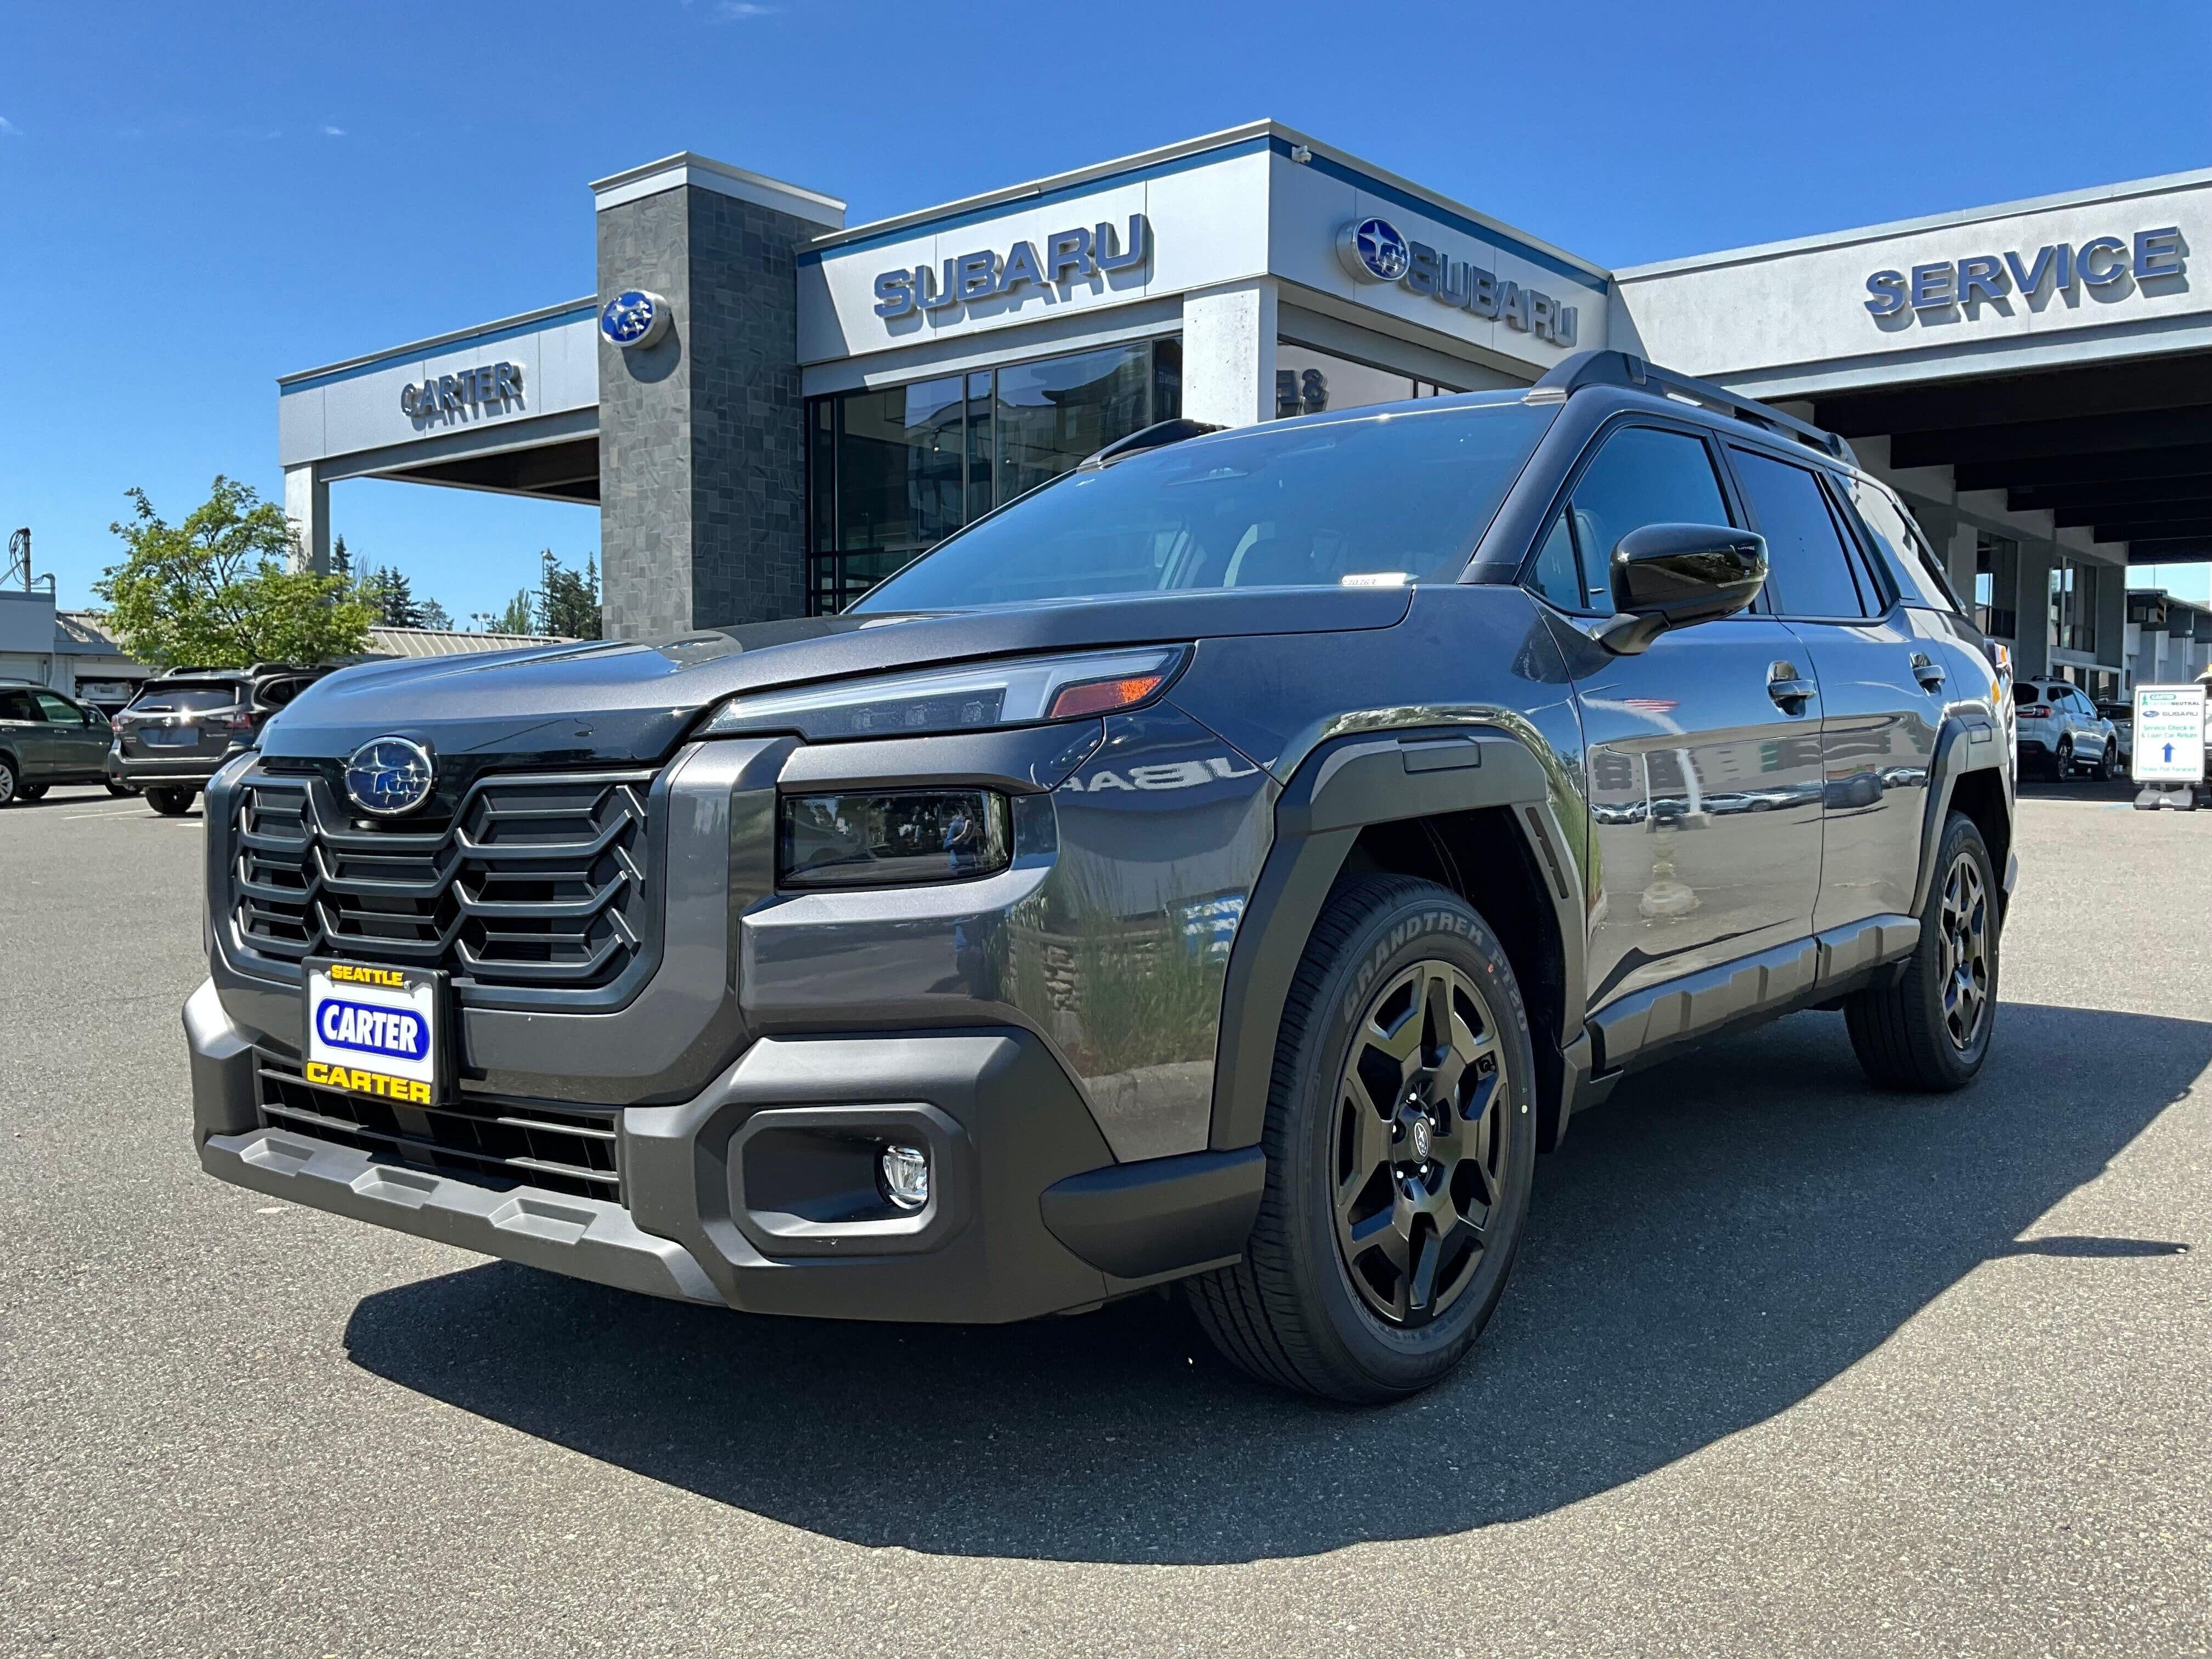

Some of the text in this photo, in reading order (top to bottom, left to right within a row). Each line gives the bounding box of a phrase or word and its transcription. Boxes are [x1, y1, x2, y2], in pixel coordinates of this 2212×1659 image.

[873, 213, 1148, 318] SUBARU
[1404, 241, 1578, 348] SUBARU
[1864, 226, 2180, 316] SERVICE
[400, 360, 522, 417] CARTER
[331, 964, 404, 987] SEATTLE
[1343, 912, 1484, 1023] GRANDTREK
[323, 1005, 418, 1053] CARTER
[307, 1062, 431, 1104] CARTER
